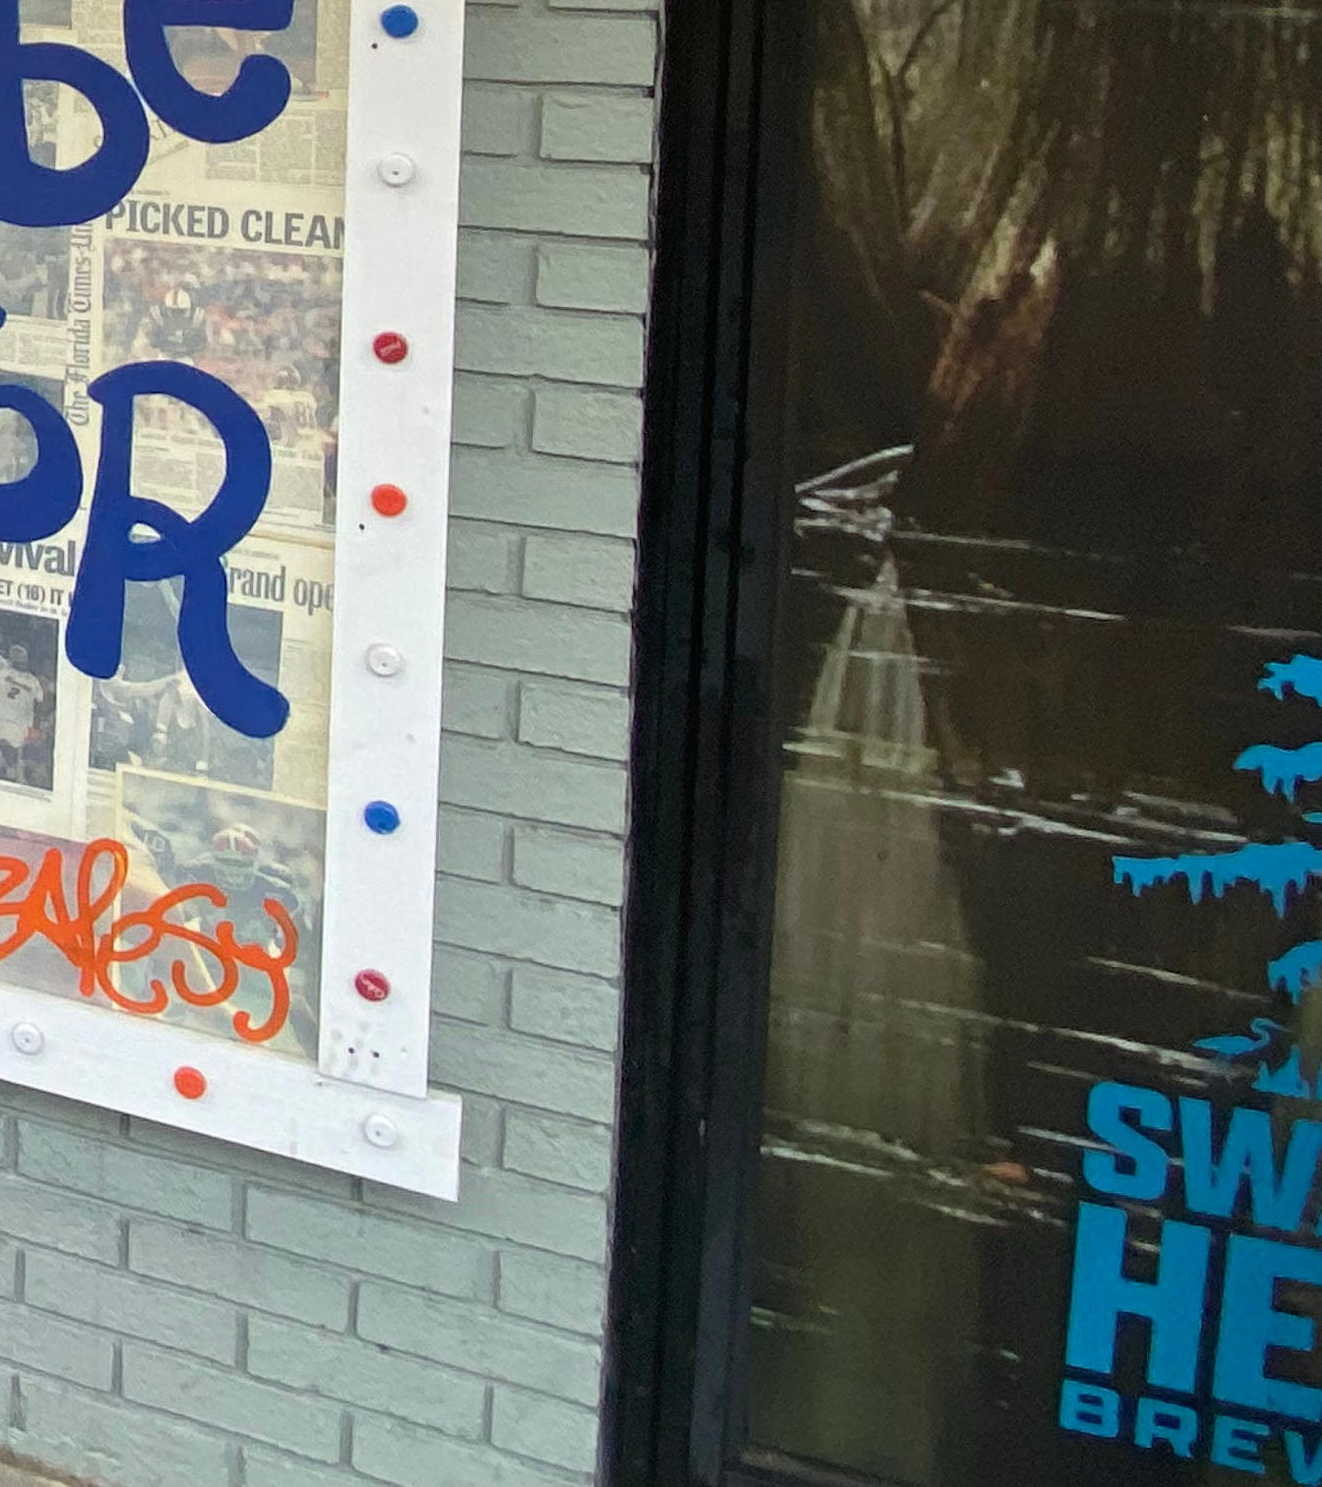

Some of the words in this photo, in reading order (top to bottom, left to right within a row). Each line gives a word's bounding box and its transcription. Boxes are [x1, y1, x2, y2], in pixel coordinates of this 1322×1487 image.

[105, 198, 230, 240] PICKED
[65, 317, 91, 385] Florida
[16, 583, 47, 606] (16)
[49, 586, 65, 606] IT
[223, 564, 286, 602] rand
